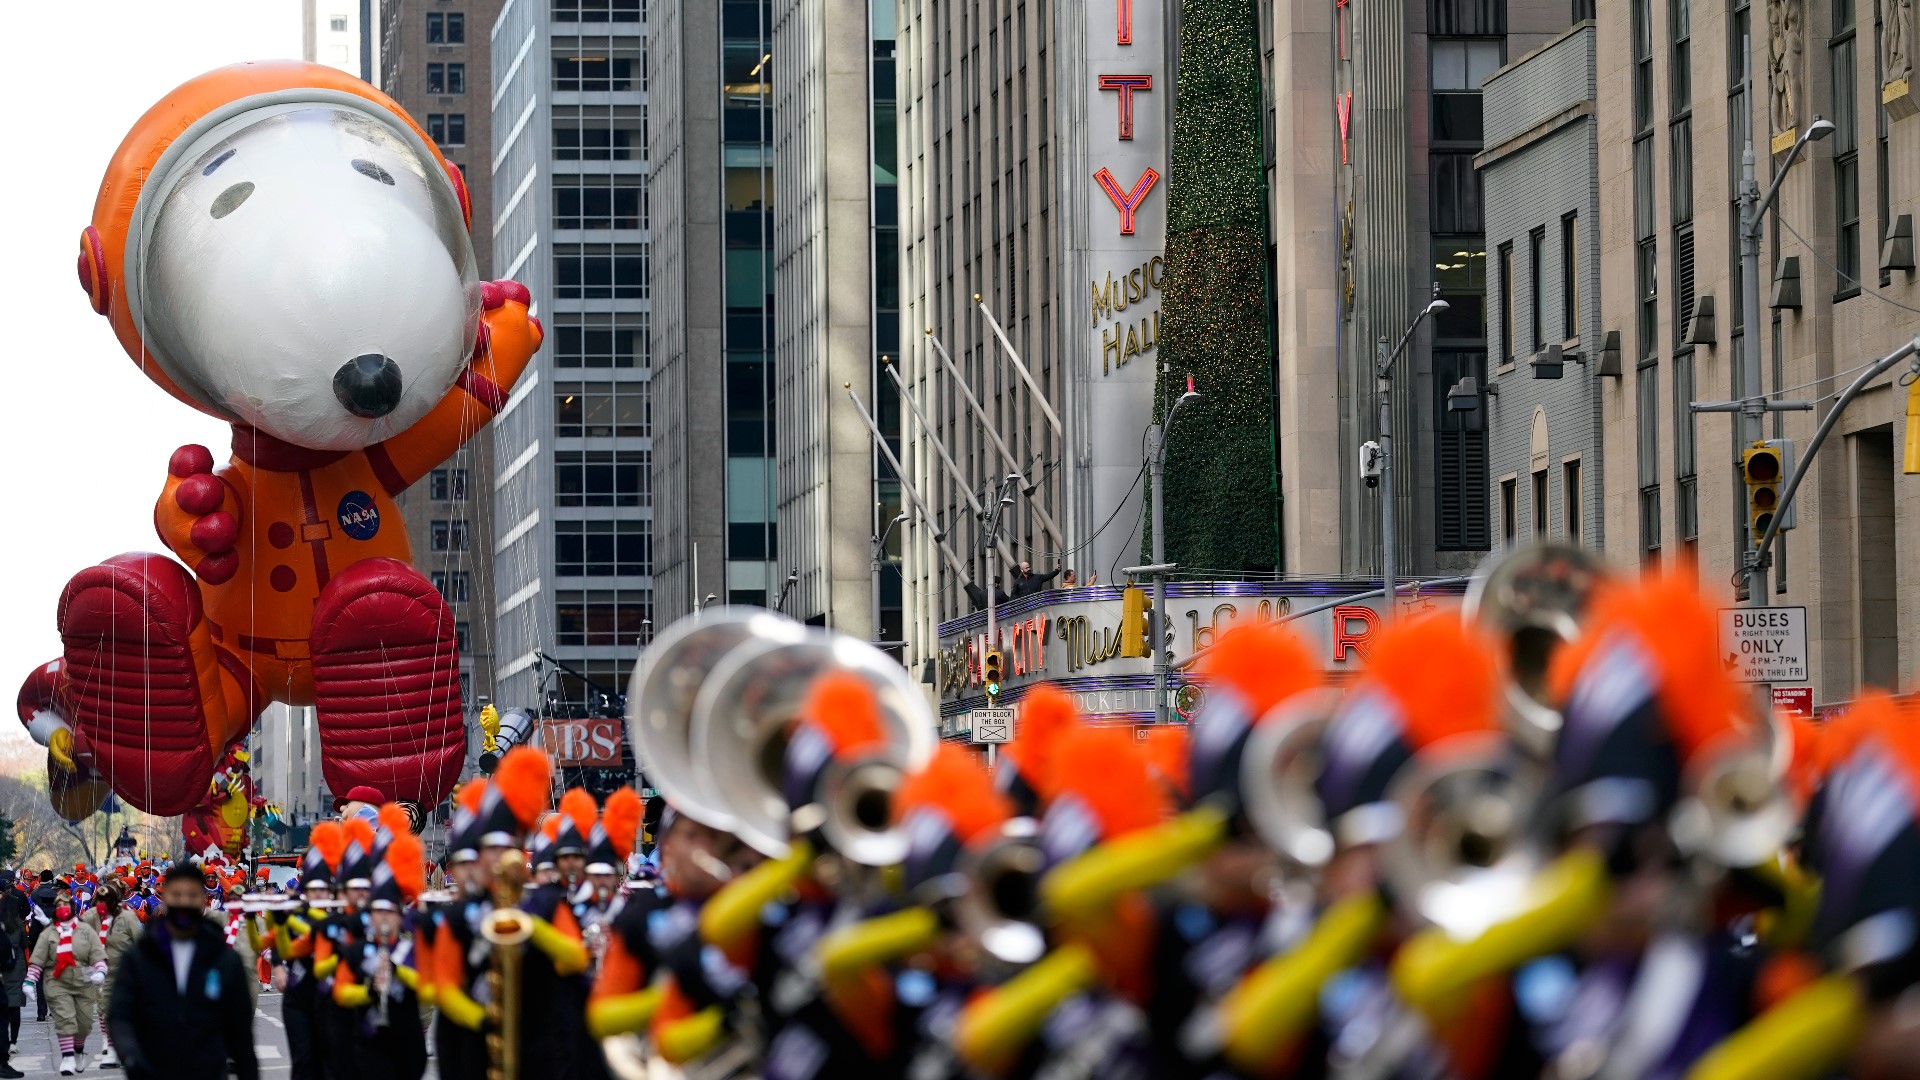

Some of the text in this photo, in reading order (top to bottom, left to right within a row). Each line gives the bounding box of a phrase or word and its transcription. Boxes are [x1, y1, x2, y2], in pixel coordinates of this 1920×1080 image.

[1091, 255, 1165, 329] MUSIC
[341, 508, 378, 526] NASA
[1734, 613, 1789, 628] BUSES
[1012, 613, 1046, 677] CITY
[1741, 639, 1784, 654] ONLY
[1744, 667, 1803, 677] MON THRU FRI
[531, 723, 617, 762] CBS
